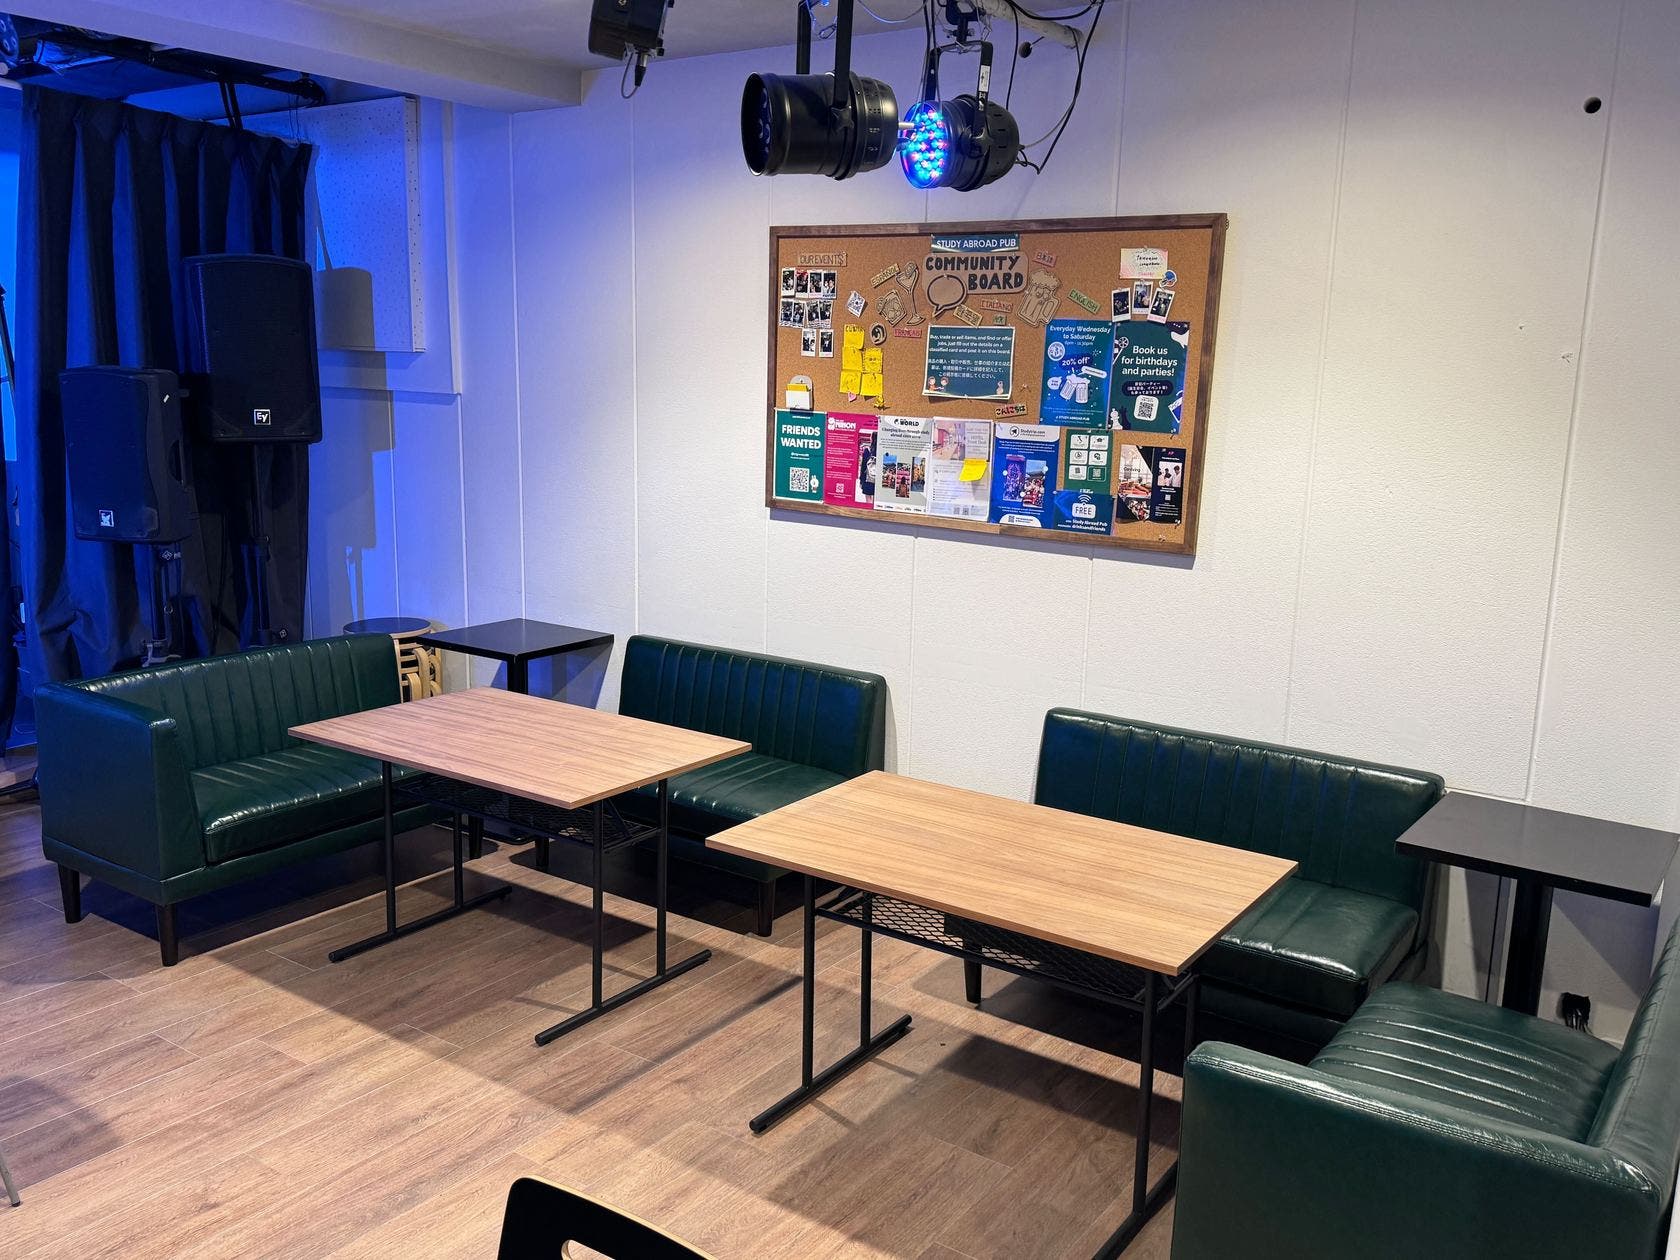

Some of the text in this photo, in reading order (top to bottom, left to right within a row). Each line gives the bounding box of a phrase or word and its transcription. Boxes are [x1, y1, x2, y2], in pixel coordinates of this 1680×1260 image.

[937, 239, 1016, 248] STUDY ABROAD PUB
[925, 255, 1020, 271] COMMUNITY
[968, 272, 1023, 291] BOARD
[1070, 289, 1098, 312] ENGLISH
[1050, 325, 1111, 334] Everyday Wednesday
[1133, 346, 1155, 354] Book
[1062, 358, 1076, 366] 20%
[1121, 356, 1178, 367] for birthdays
[1122, 367, 1174, 377] and parties!
[996, 405, 1026, 415] こんにちは
[781, 424, 821, 436] FRIENDS
[780, 437, 822, 449] WANTED
[1075, 506, 1092, 515] FREE
